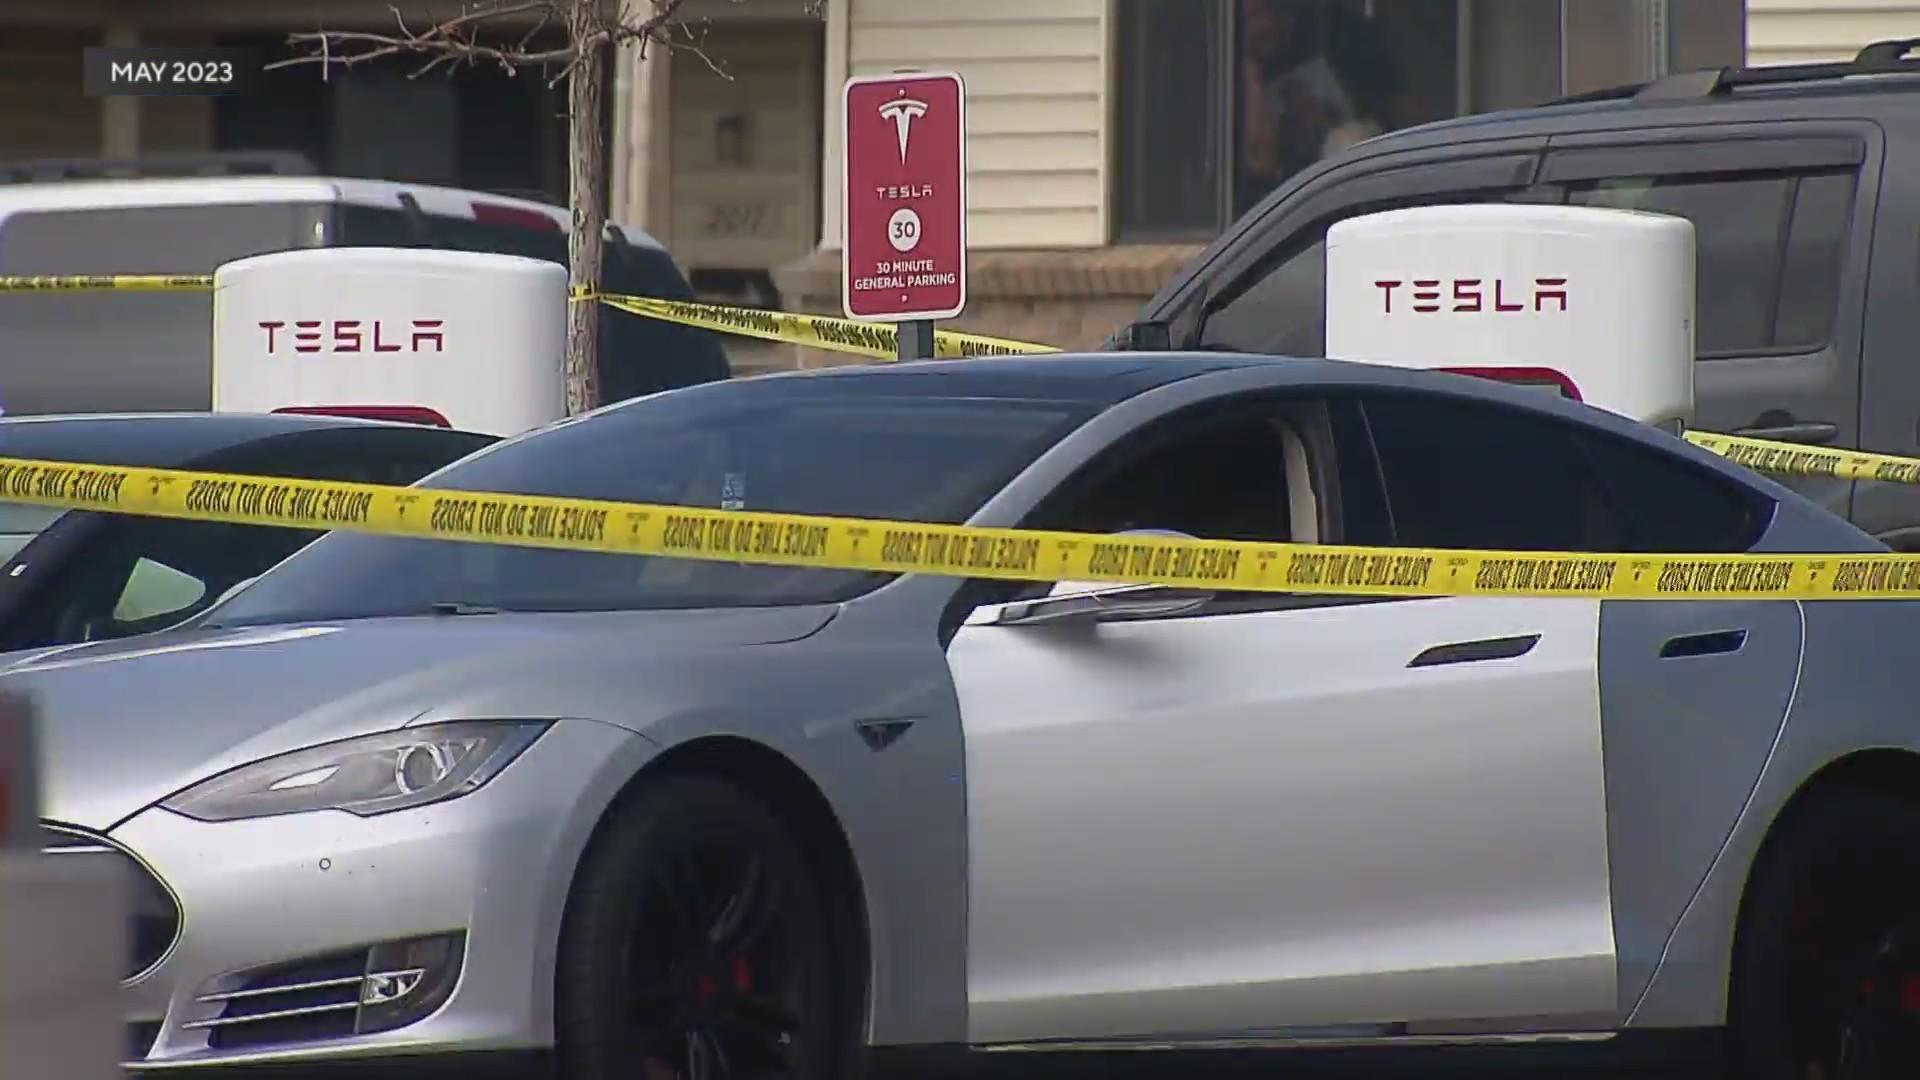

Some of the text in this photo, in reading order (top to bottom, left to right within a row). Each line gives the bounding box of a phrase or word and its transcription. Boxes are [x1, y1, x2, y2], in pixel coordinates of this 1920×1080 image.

[876, 184, 932, 199] TESLA
[893, 221, 916, 239] 30
[876, 259, 934, 274] 30 MINUTE
[854, 272, 956, 291] GENERAL PARKING
[1374, 278, 1568, 314] TESLA
[258, 320, 444, 353] TESLA
